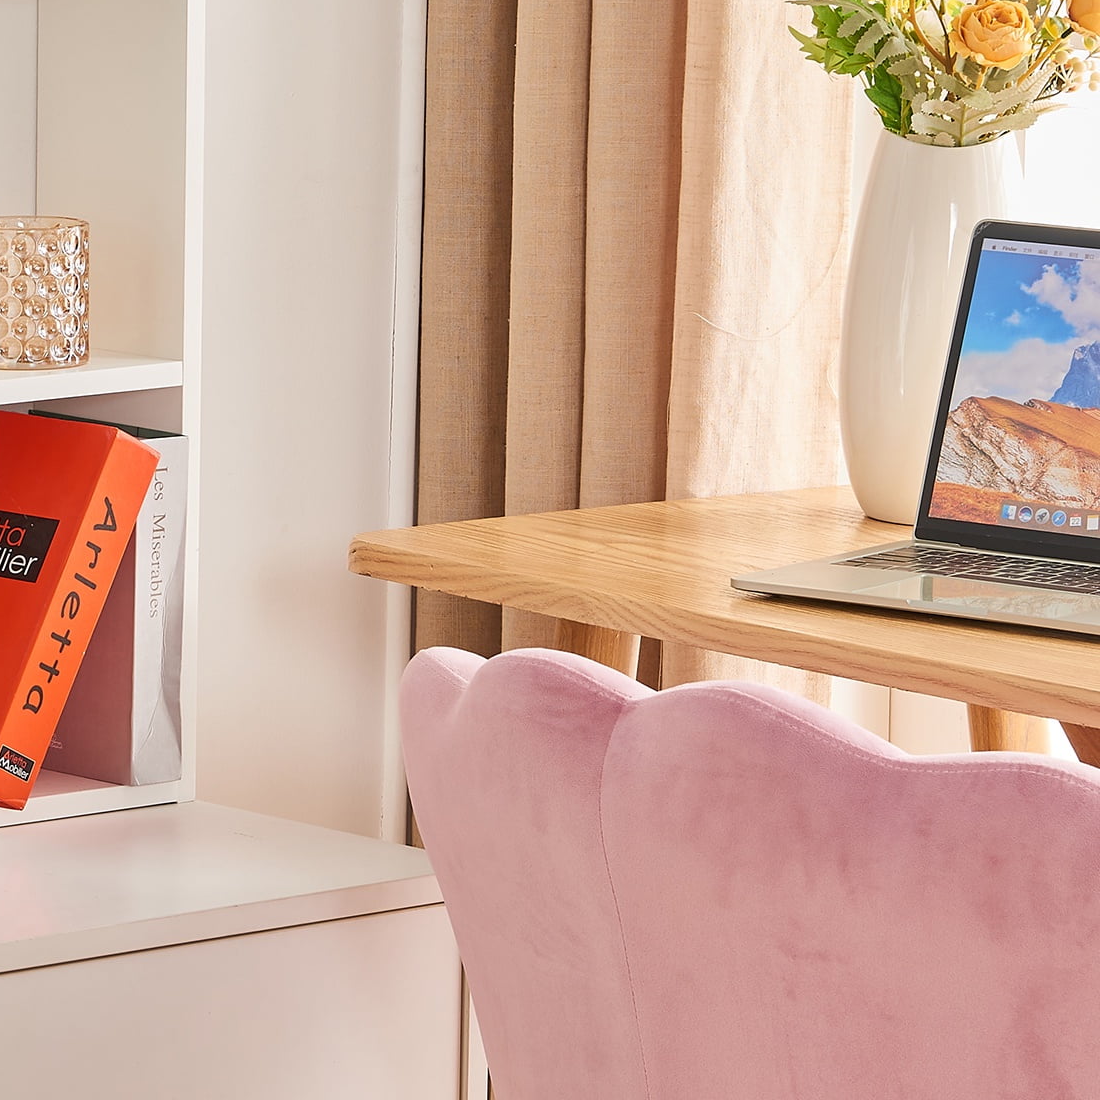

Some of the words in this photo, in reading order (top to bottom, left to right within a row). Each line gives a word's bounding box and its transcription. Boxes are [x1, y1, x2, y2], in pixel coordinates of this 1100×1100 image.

[153, 466, 169, 501] Les
[1071, 518, 1080, 526] 22
[149, 513, 167, 619] Miserables
[21, 496, 119, 716] Arletta
[3, 750, 28, 769] Arletta
